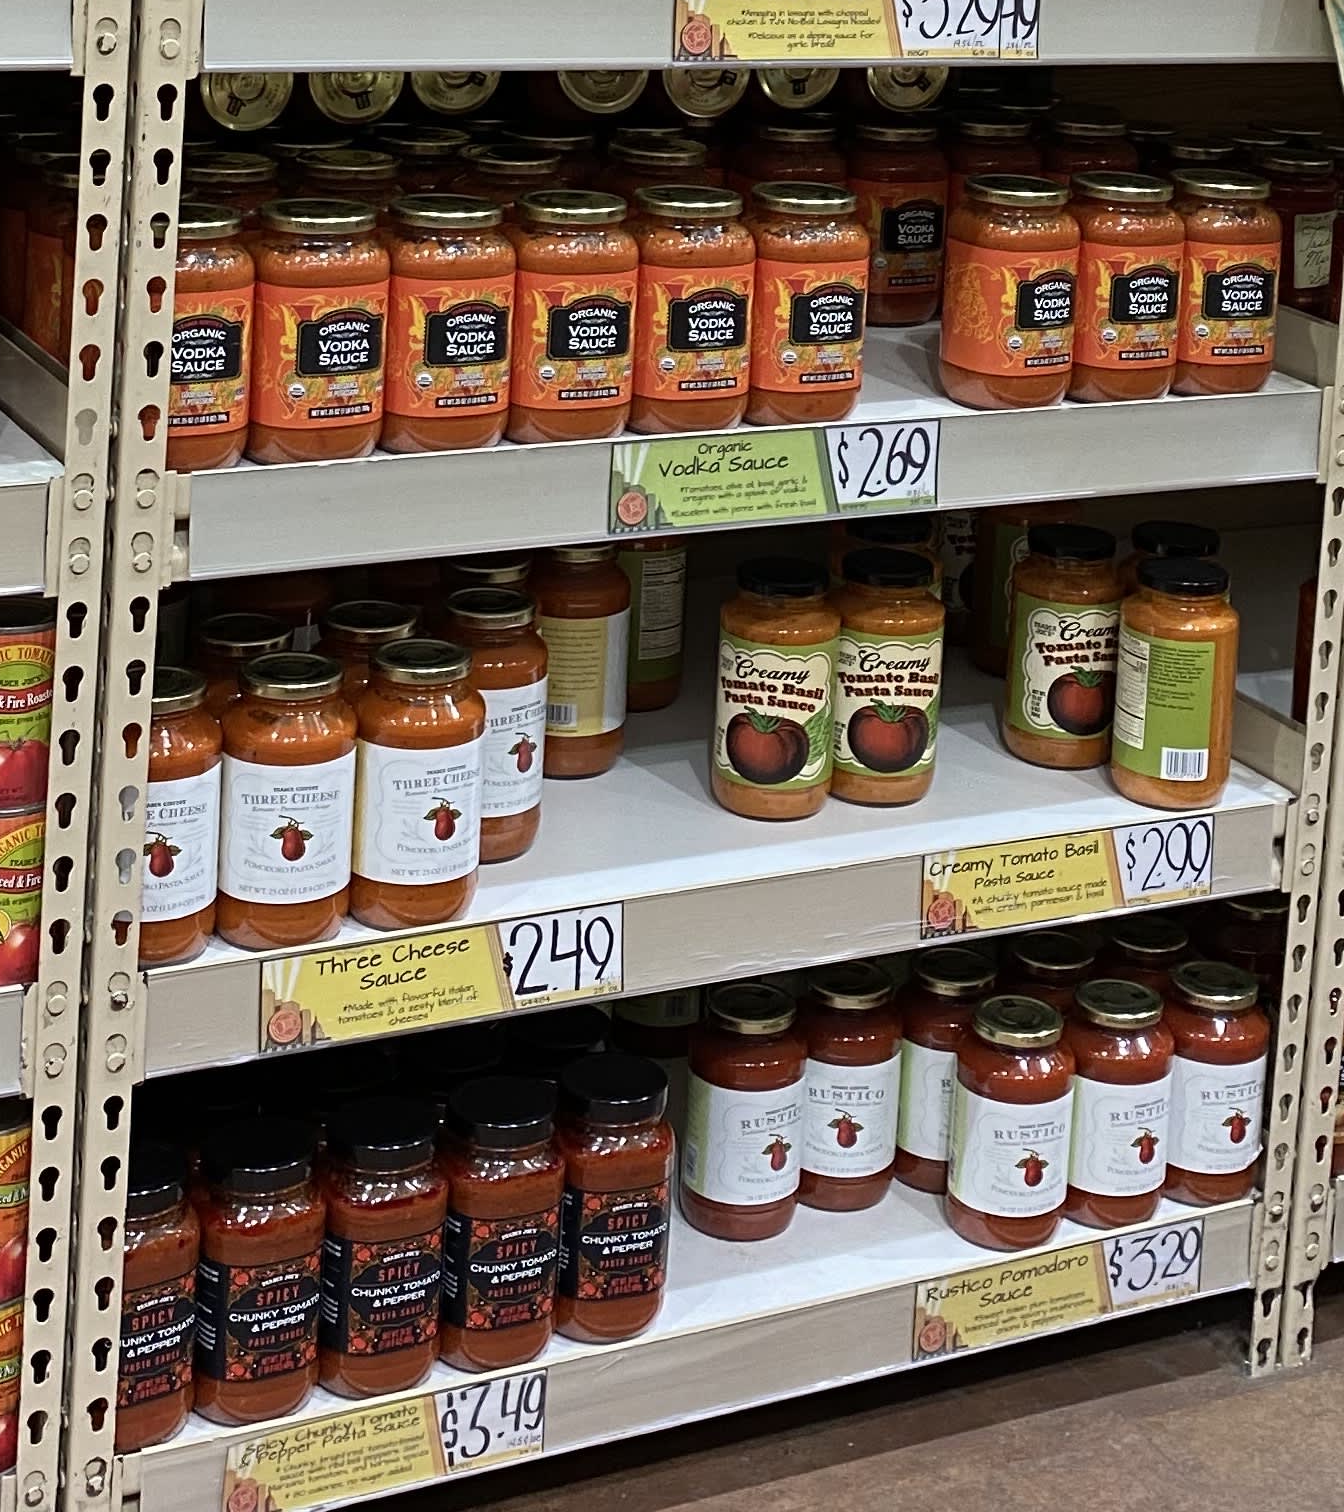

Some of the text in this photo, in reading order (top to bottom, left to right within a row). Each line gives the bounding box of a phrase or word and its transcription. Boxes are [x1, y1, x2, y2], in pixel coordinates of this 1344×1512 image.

[567, 321, 618, 337] VODKA
[567, 334, 617, 351] SAUCE
[698, 439, 752, 460] Organic
[838, 427, 931, 499] $2.69
[658, 453, 789, 478] Vodka Sauce
[858, 648, 931, 674] Creamy
[242, 788, 340, 806] THREE CHEESE
[929, 840, 1099, 877] Creamy Tomato Basil
[1125, 819, 1211, 892] $2.99
[974, 868, 1055, 888] Pasta Sauce
[316, 935, 470, 976] Three Cheese
[502, 916, 615, 996] $2.49
[360, 964, 427, 991] Sauce
[808, 1086, 886, 1103] RUSTICO
[378, 1262, 421, 1282] SPICY
[1108, 1226, 1202, 1292] $3.29
[351, 1270, 442, 1299] CHUNKY TOMATO
[926, 1254, 1090, 1303] Rustico Pomodoro
[978, 1284, 1034, 1308] Sauce
[245, 1405, 419, 1462] Spicy Chunky Tomato
[255, 1437, 318, 1470] Pepper
[322, 1426, 367, 1449] Pasta
[371, 1415, 421, 1438] Sauce
